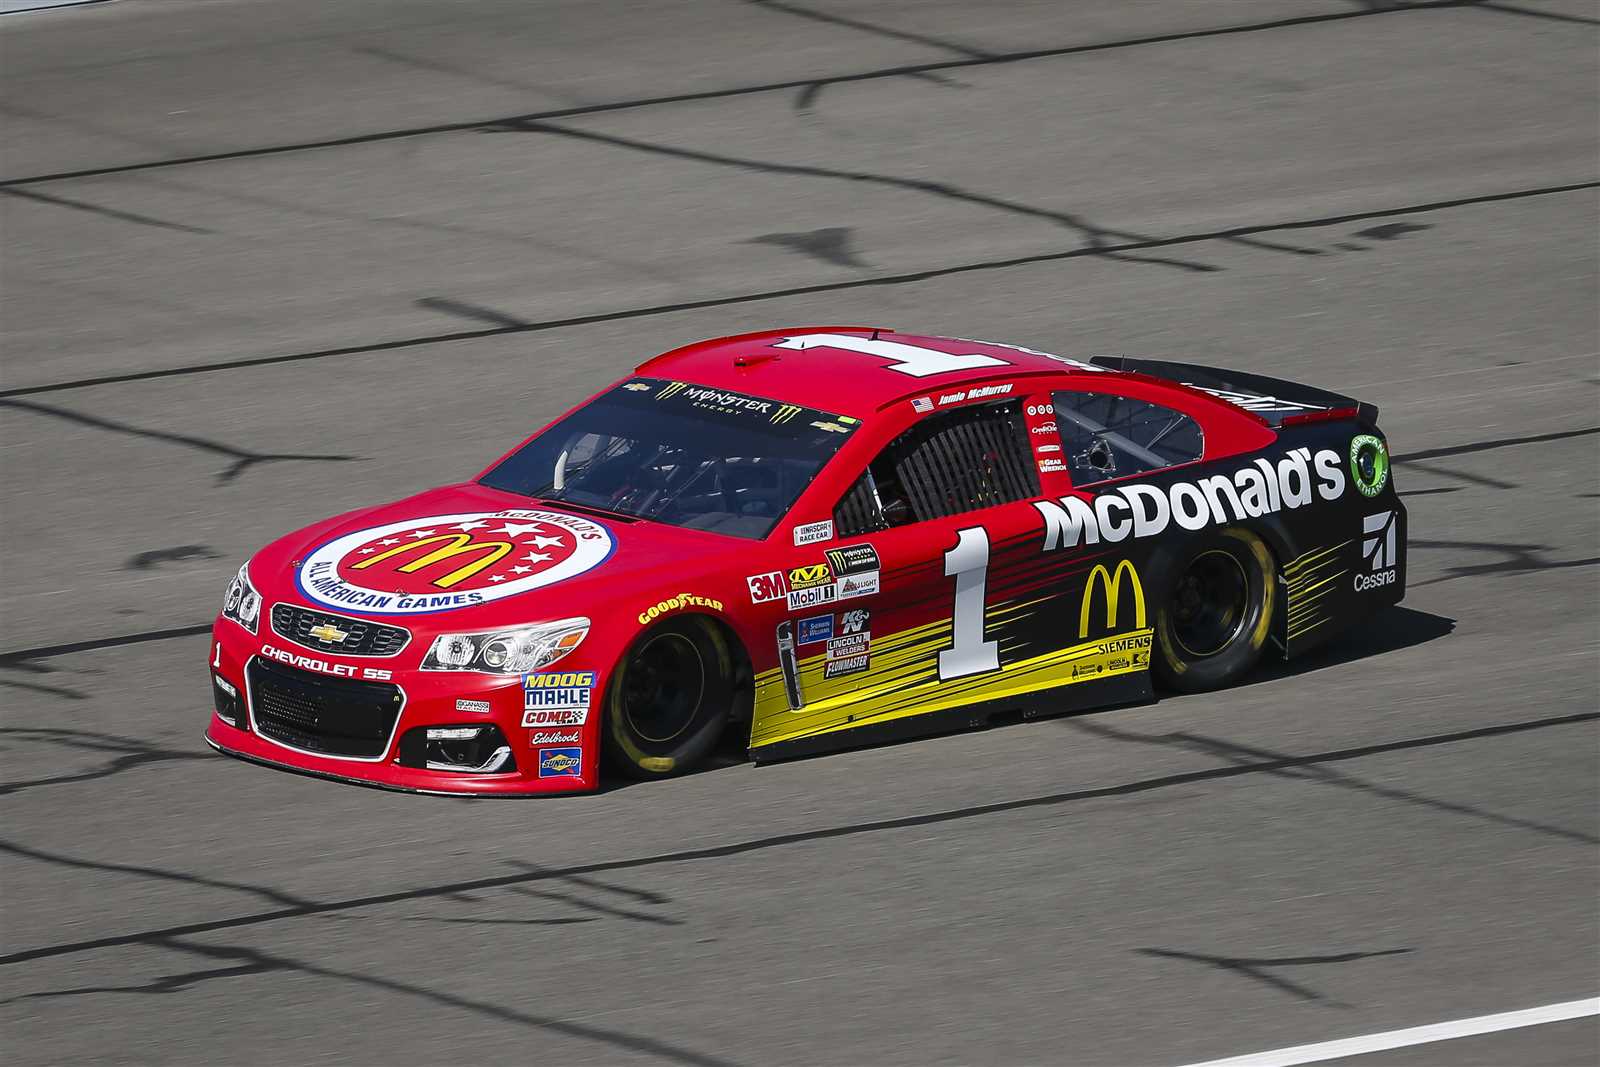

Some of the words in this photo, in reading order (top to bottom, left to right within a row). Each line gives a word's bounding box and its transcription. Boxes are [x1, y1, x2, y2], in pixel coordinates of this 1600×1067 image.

[938, 392, 965, 406] Jamie
[967, 384, 1014, 400] McMurray
[1351, 434, 1385, 464] AMERICAN
[1356, 468, 1388, 496] ETHANOL
[1034, 447, 1345, 551] McDonald's
[800, 533, 815, 543] RACE
[816, 531, 828, 540] CAR
[309, 560, 333, 578] ALL
[751, 574, 785, 600] 3M
[1354, 569, 1396, 592] Cessna
[311, 576, 393, 608] AMERICAN
[397, 592, 484, 609] GAMES
[790, 588, 821, 606] Mobil
[638, 593, 723, 625] GOODYEAR
[939, 526, 1000, 680] 1
[829, 635, 864, 649] LINCOLN
[835, 646, 866, 656] WELDERS
[1099, 637, 1150, 655] SIEMENS
[213, 642, 220, 668] 1
[261, 644, 358, 677] CHEVROLET
[363, 668, 393, 681] SS
[826, 655, 868, 678] FLOWMASTER
[525, 673, 593, 688] MOOG
[526, 689, 588, 705] MAHLE
[525, 711, 572, 724] COMP
[532, 731, 579, 745] Edelbrock
[543, 759, 579, 768] SUNOCO
